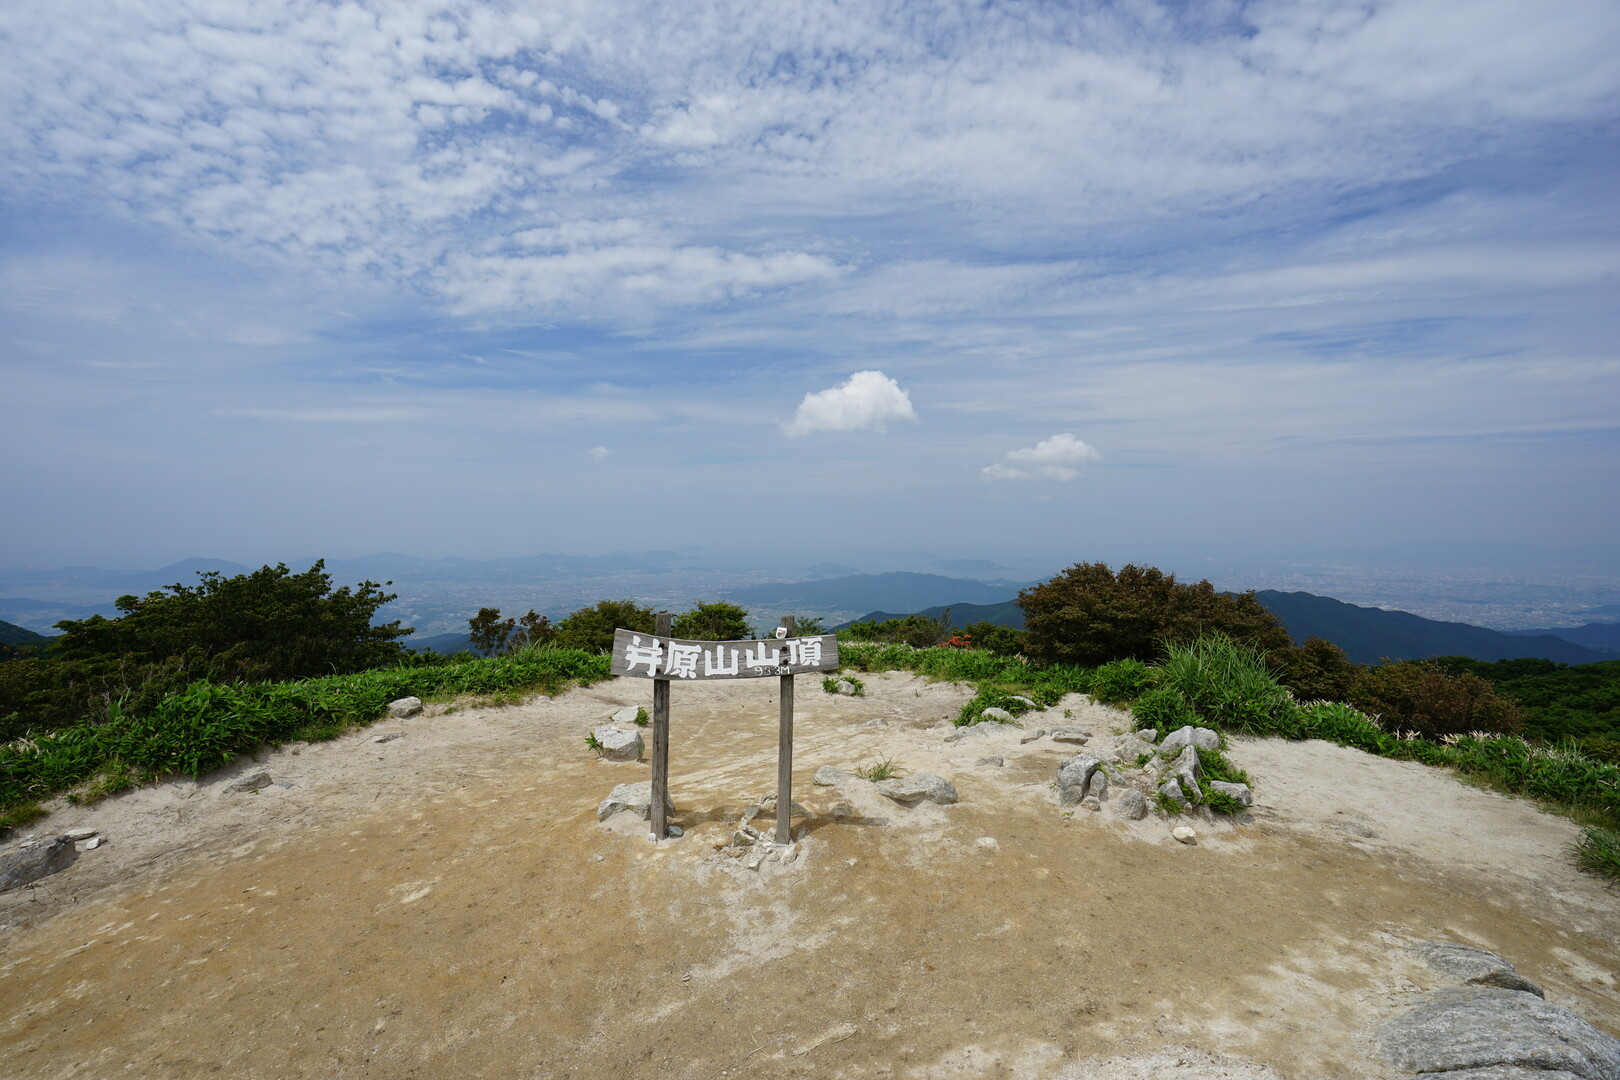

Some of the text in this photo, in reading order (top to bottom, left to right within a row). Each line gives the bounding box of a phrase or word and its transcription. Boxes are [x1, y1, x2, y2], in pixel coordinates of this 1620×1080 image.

[625, 636, 823, 679] 井原山山頂
